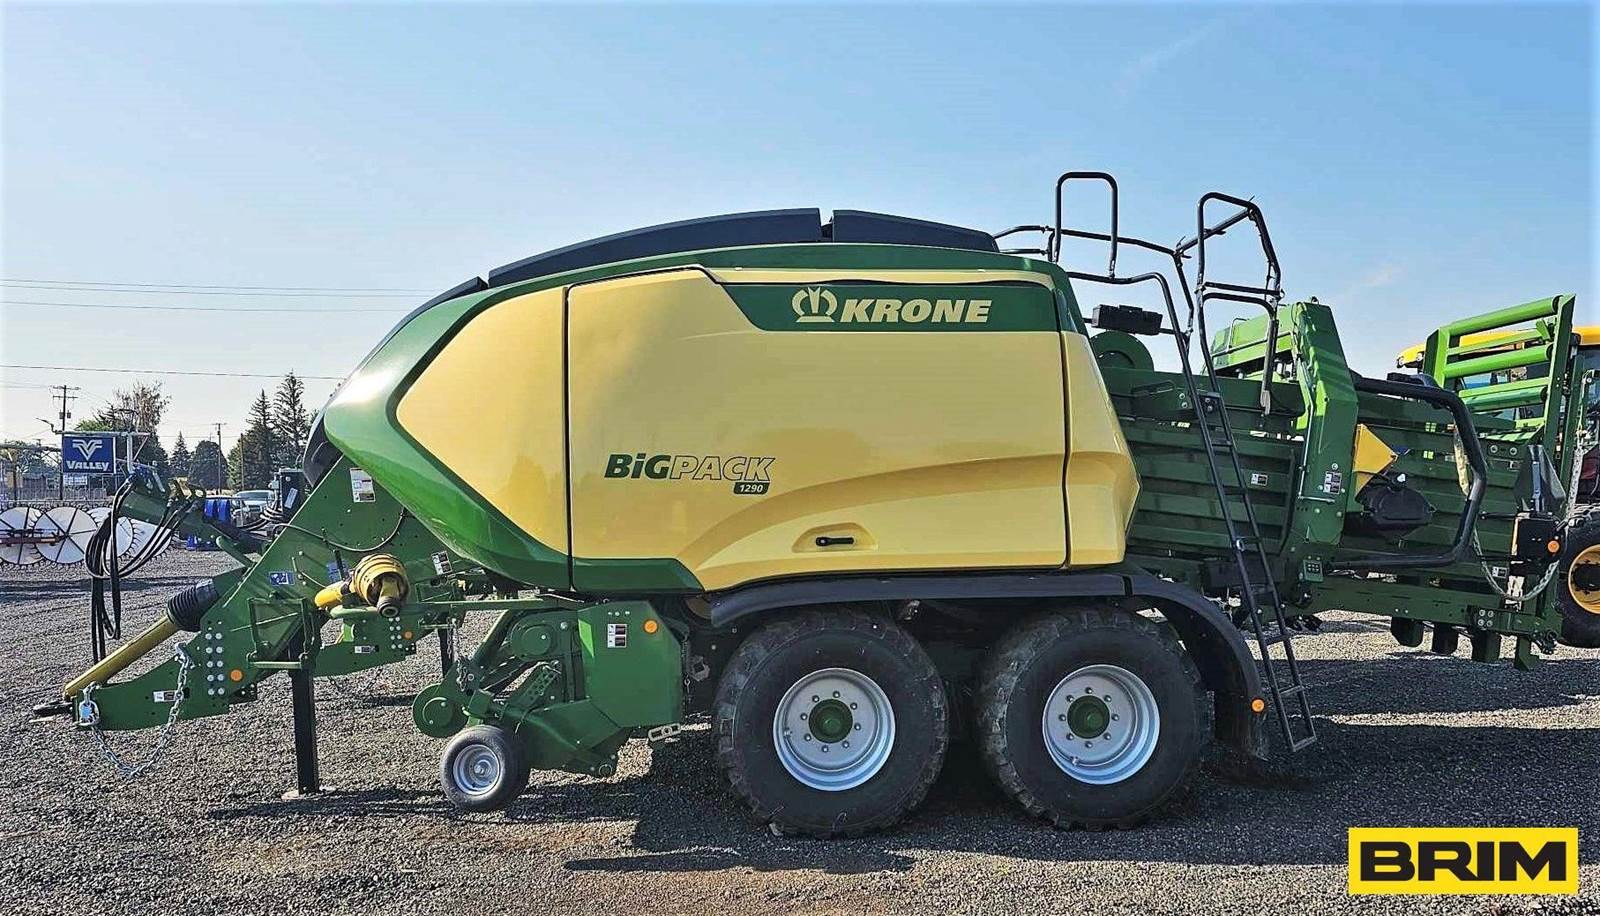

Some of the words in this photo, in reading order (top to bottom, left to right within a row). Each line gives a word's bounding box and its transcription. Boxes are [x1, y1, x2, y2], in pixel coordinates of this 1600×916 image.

[840, 299, 992, 323] KRONE
[66, 460, 109, 471] VALLEY
[739, 484, 764, 494] 1290
